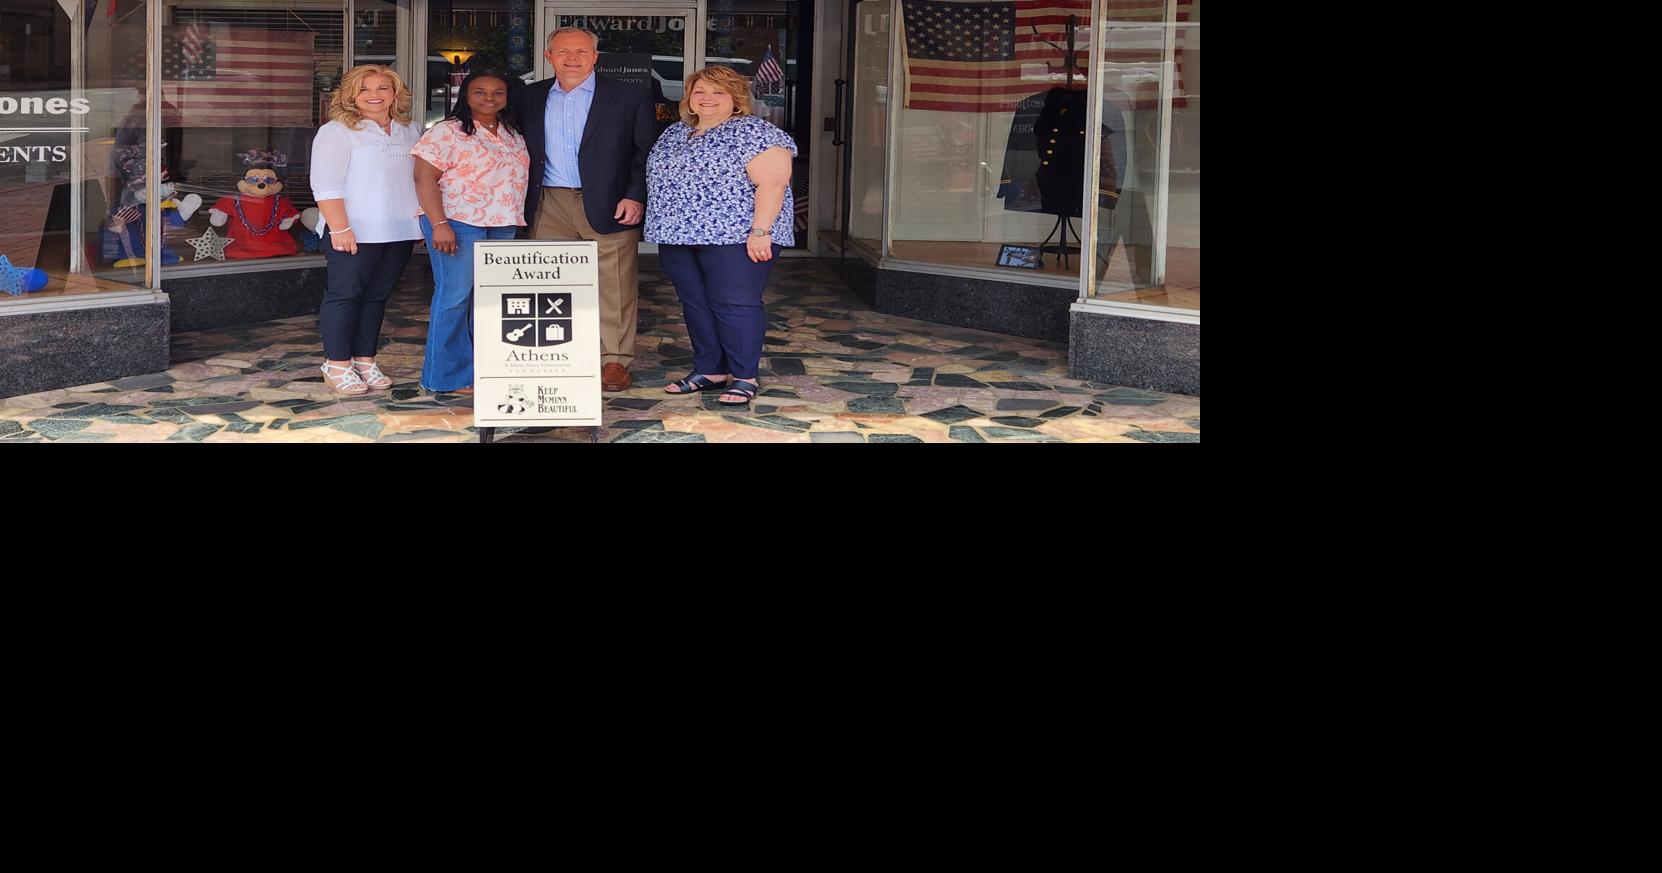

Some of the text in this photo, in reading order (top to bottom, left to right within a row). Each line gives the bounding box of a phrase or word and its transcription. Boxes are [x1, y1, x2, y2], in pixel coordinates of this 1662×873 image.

[484, 251, 589, 265] Beautification
[512, 266, 561, 280] Award
[505, 350, 569, 361] Athens
